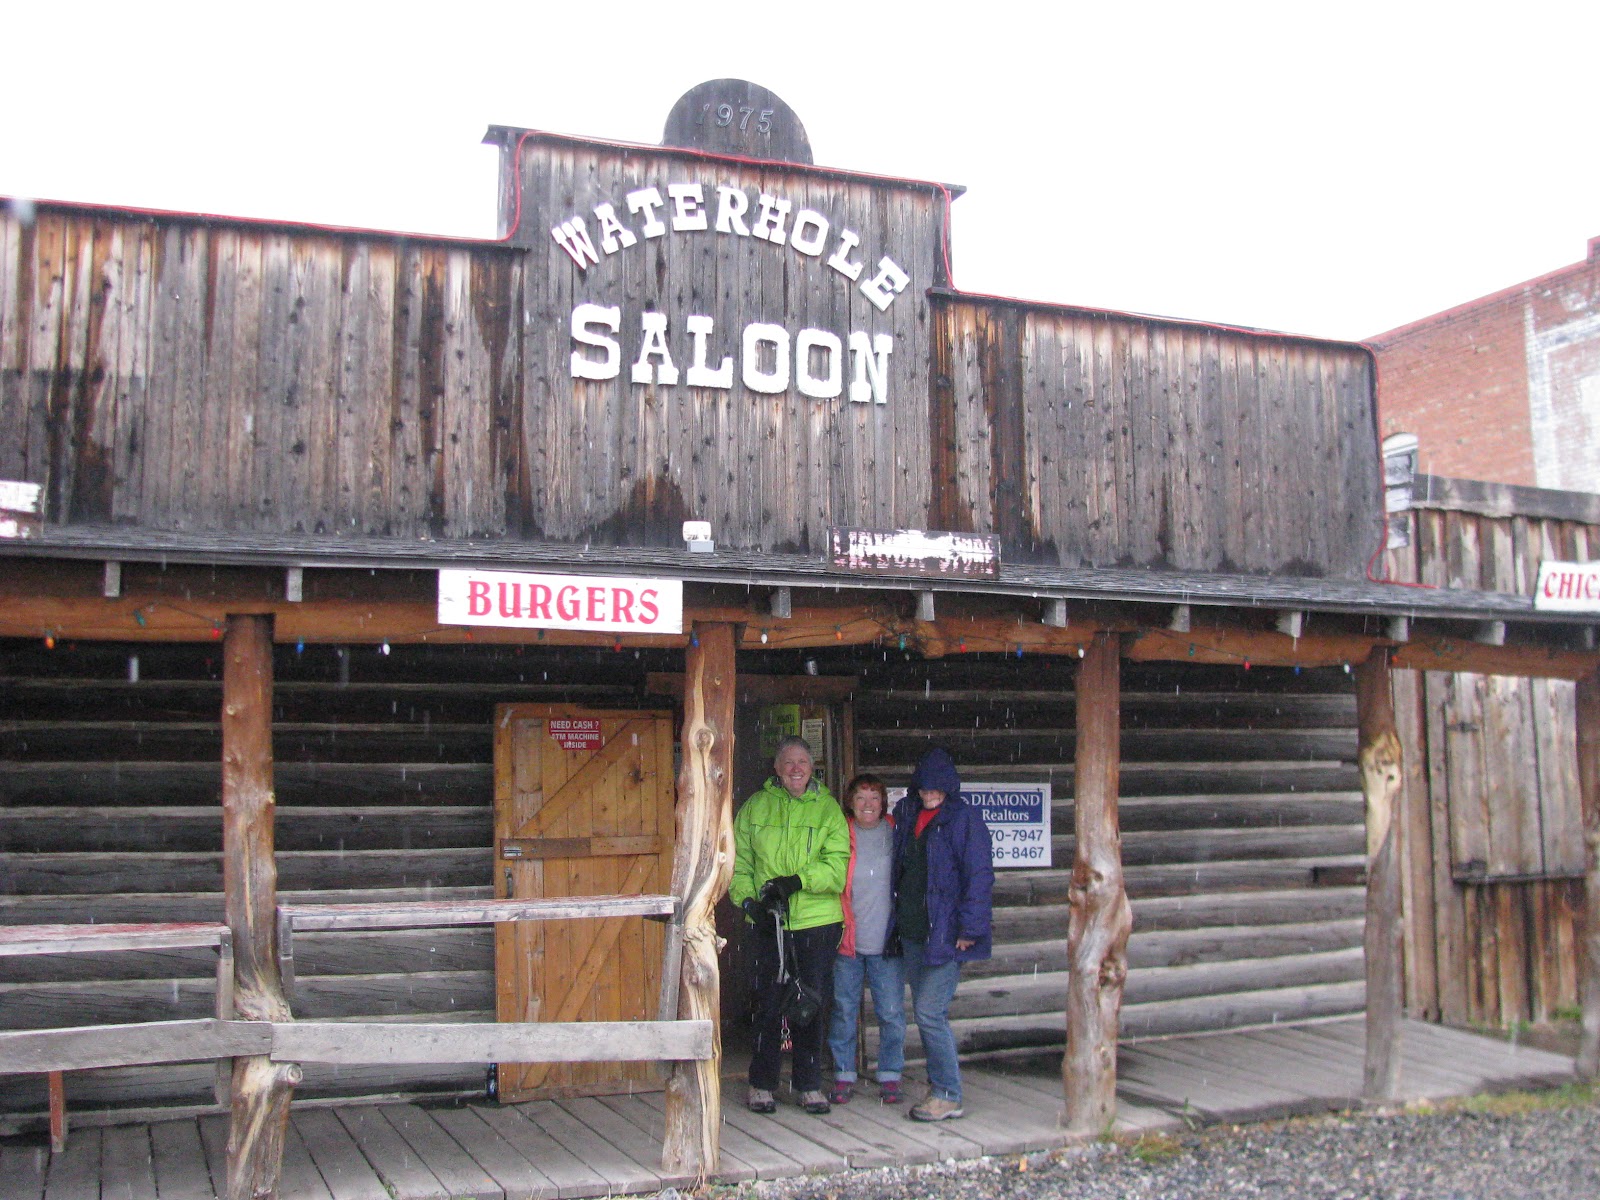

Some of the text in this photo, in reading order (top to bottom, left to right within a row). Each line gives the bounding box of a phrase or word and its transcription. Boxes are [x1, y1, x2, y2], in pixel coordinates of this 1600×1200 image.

[695, 103, 774, 133] 1975
[551, 183, 910, 312] WATERHOLE
[570, 303, 893, 404] SALOON
[1543, 571, 1600, 600] CHIC
[467, 580, 660, 625] BURGERS
[550, 720, 571, 729] NEED
[573, 720, 593, 729] CASH
[971, 794, 1040, 806] DIAMOND
[982, 809, 1030, 821] Realtors
